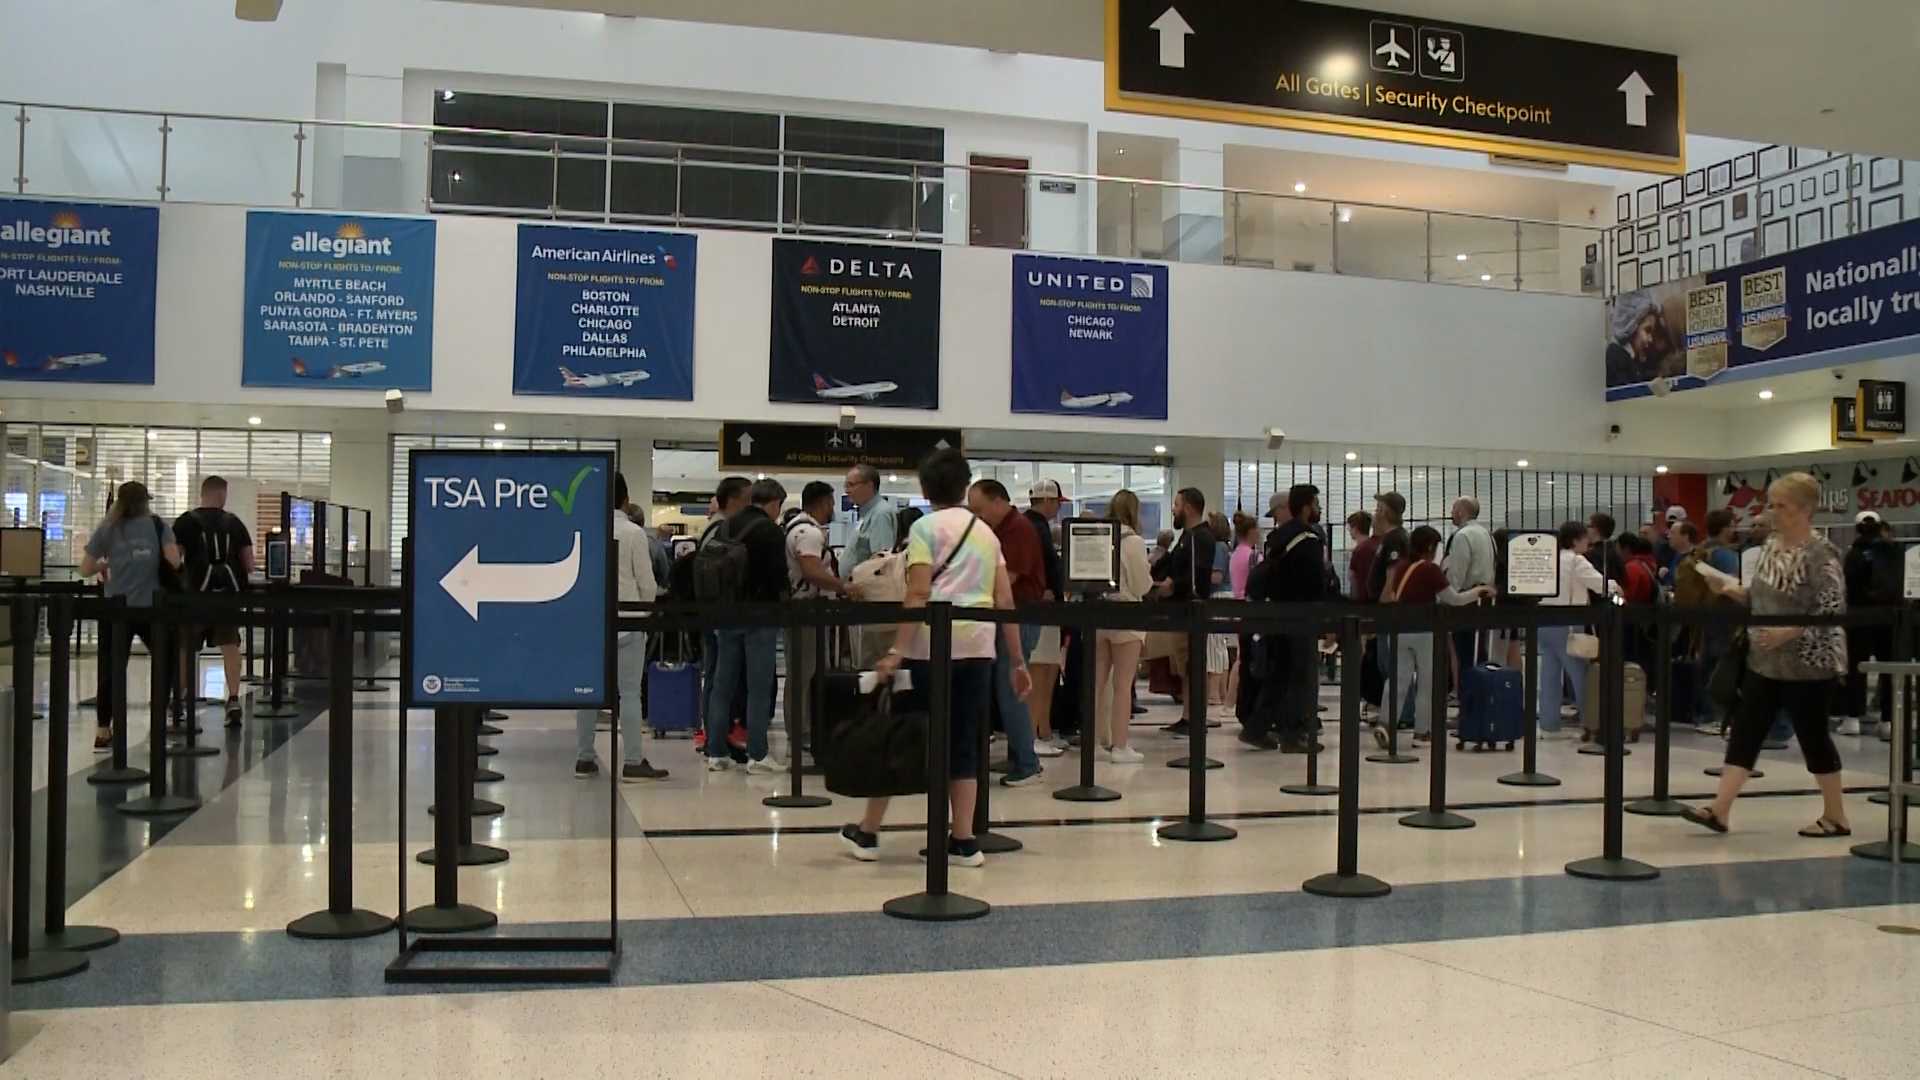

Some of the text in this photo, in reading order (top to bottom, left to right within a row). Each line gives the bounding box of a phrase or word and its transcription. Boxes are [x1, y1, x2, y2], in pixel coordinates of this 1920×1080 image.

[1275, 73, 1300, 92] All
[1306, 77, 1360, 100] Gates
[1375, 86, 1449, 116] Security
[1452, 96, 1551, 125] Checkpoint
[1, 220, 111, 248] allegiant
[291, 231, 392, 258] allegiant
[0, 252, 35, 262] N-STOP
[531, 245, 656, 265] American Airlines
[324, 262, 359, 273] FLIGHTS
[829, 258, 913, 279] DELTA
[1805, 245, 1920, 295] Nationall
[0, 267, 123, 284] ORT LAUDERDALE
[547, 272, 589, 283] NON-STOP
[590, 274, 624, 285] FLIGHTS
[1028, 271, 1124, 292] UNITED
[15, 283, 95, 298] NASHVILLE
[294, 277, 386, 292] MYRTLE BEACH
[1744, 271, 1783, 296] BEST
[274, 291, 336, 304] ORLANDO
[346, 294, 404, 306] SANFORD
[581, 289, 630, 302] BOSTON
[841, 287, 873, 297] FLIGHTS
[1688, 286, 1725, 308] BEST
[260, 305, 300, 317] PUNTA
[303, 306, 347, 318] GORDA
[357, 309, 373, 320] FT.
[376, 310, 418, 321] MYERS
[571, 303, 640, 316] CHARLOTTE
[832, 302, 881, 314] ATLANTA
[1806, 295, 1884, 330] locally
[264, 320, 328, 332] SARASOTA
[338, 323, 413, 335] BRADENTON
[578, 317, 632, 330] CHICAGO
[832, 315, 880, 328] DETROIT
[1067, 314, 1115, 328] CHICAGO
[582, 331, 628, 344] DALLAS
[1069, 327, 1113, 340] NEWARK
[288, 335, 329, 347] TAMPA
[358, 337, 389, 348] PETE
[562, 344, 647, 358] PHILADELPHIA
[423, 477, 549, 509] TSA Pre
